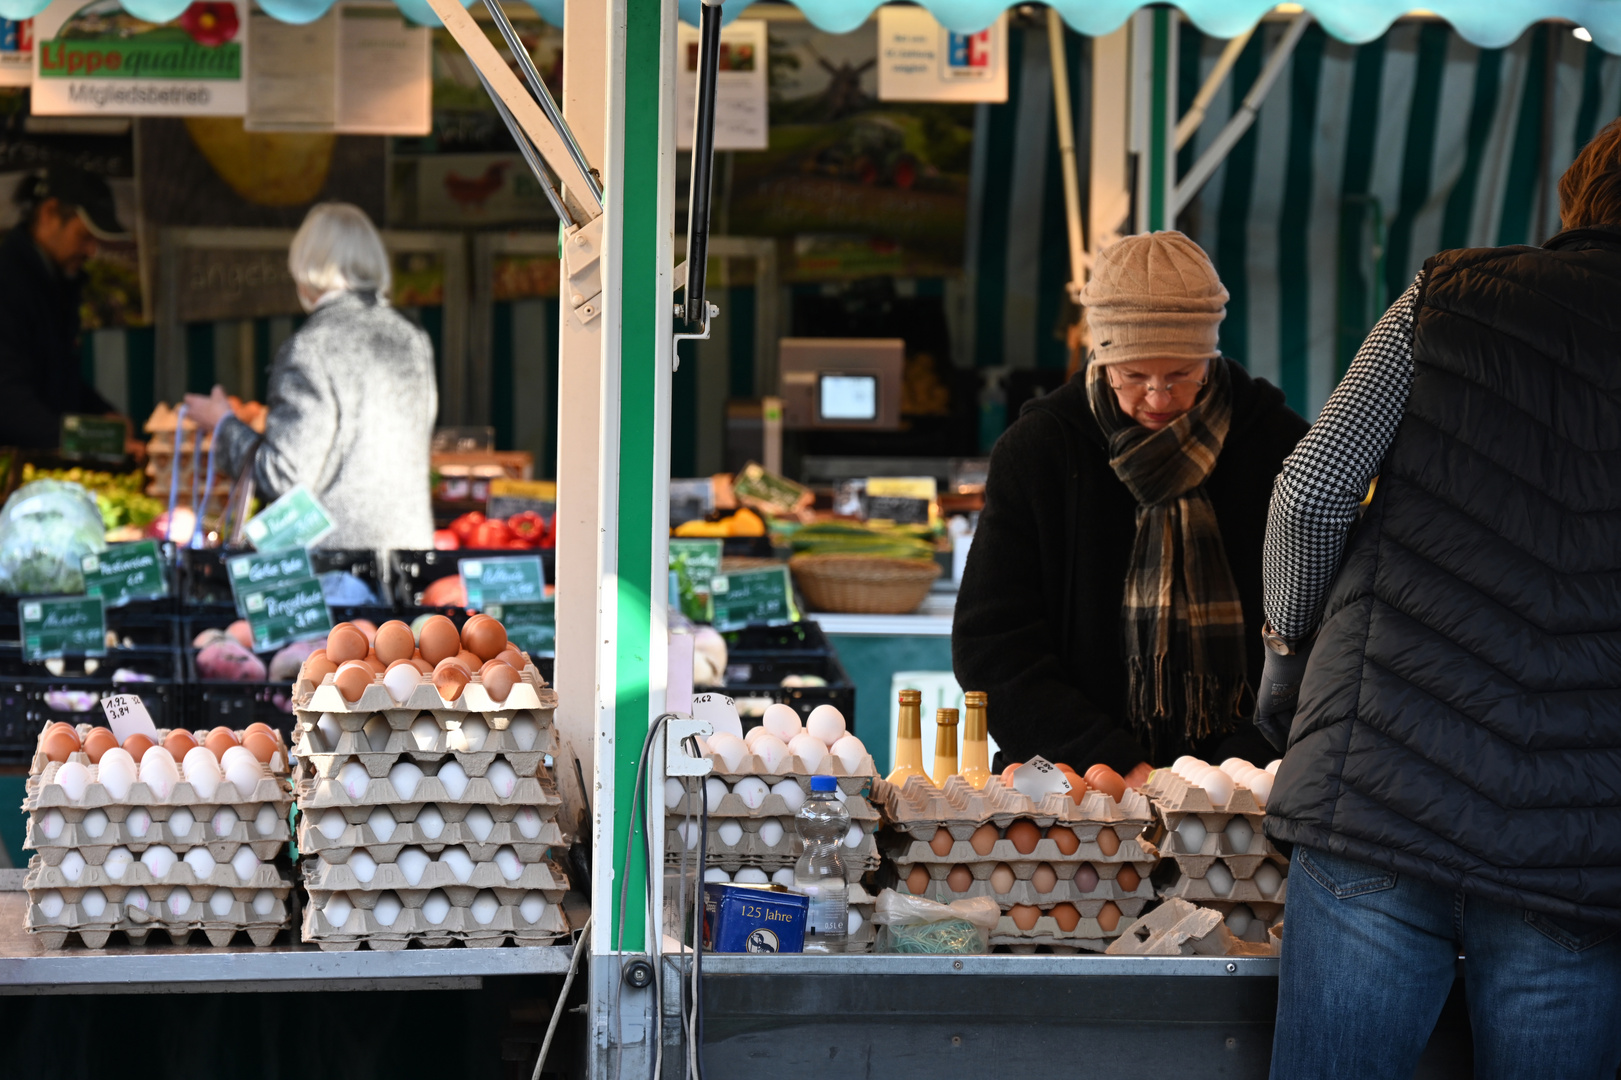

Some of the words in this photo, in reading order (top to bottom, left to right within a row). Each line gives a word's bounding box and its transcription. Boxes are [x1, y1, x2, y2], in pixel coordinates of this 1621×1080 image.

[69, 83, 210, 105] Mitgliedsbetrieb
[106, 696, 127, 709] 1,92
[109, 706, 130, 720] 3,84
[741, 905, 762, 918] 125
[765, 908, 793, 923] Jahre
